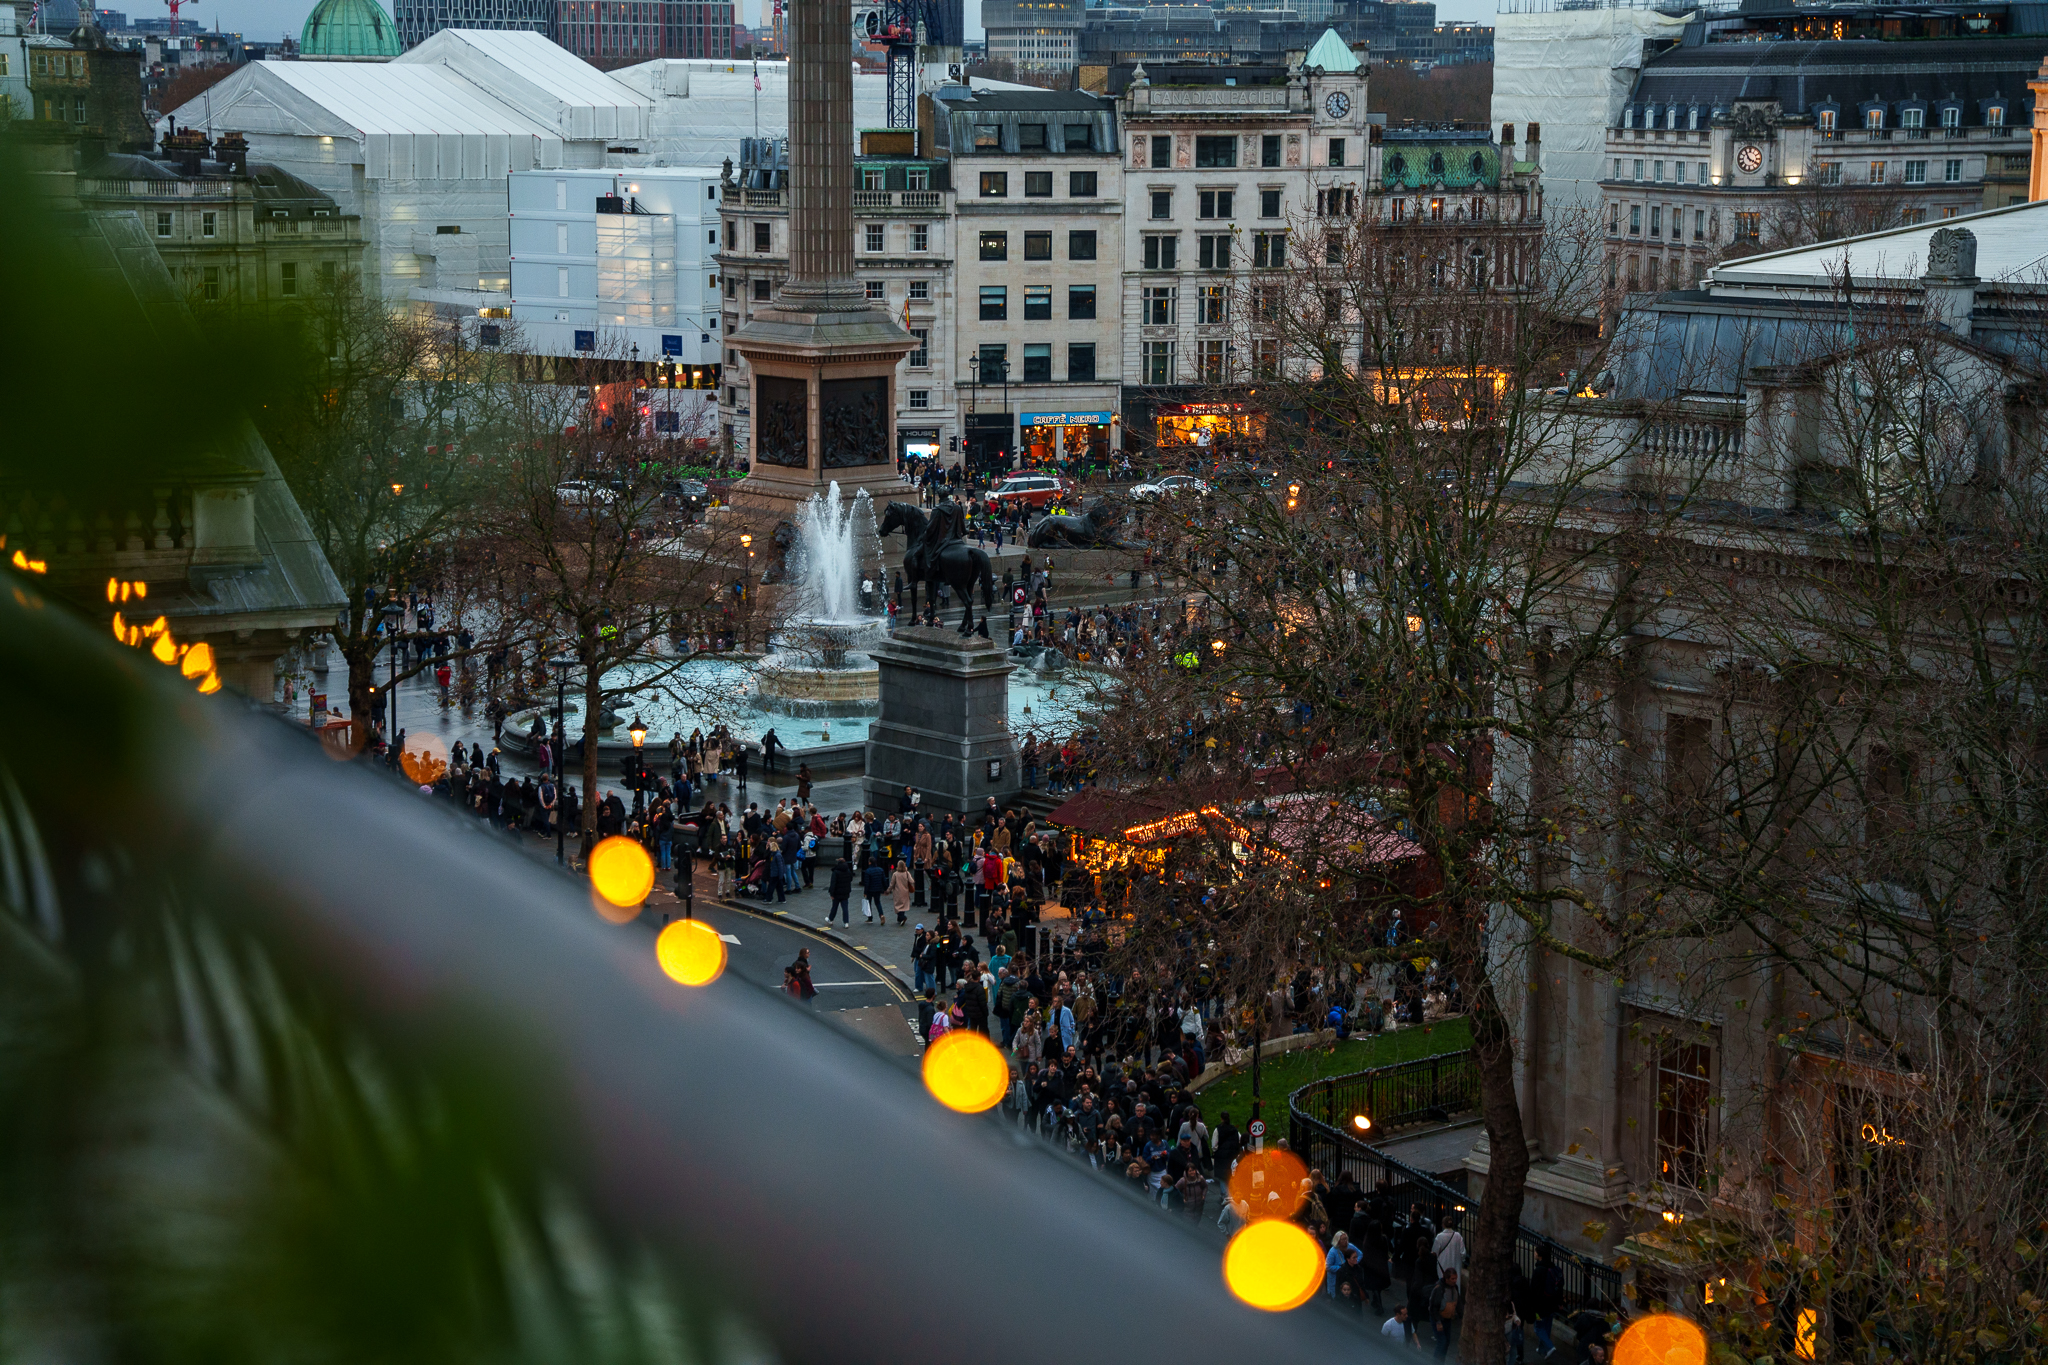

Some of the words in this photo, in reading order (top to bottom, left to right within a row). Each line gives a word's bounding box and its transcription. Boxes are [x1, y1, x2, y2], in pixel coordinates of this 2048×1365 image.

[1152, 91, 1224, 104] CANADIAN
[1231, 91, 1284, 104] PACIFIC
[1070, 415, 1099, 424] NERO
[1252, 1124, 1264, 1133] 20
